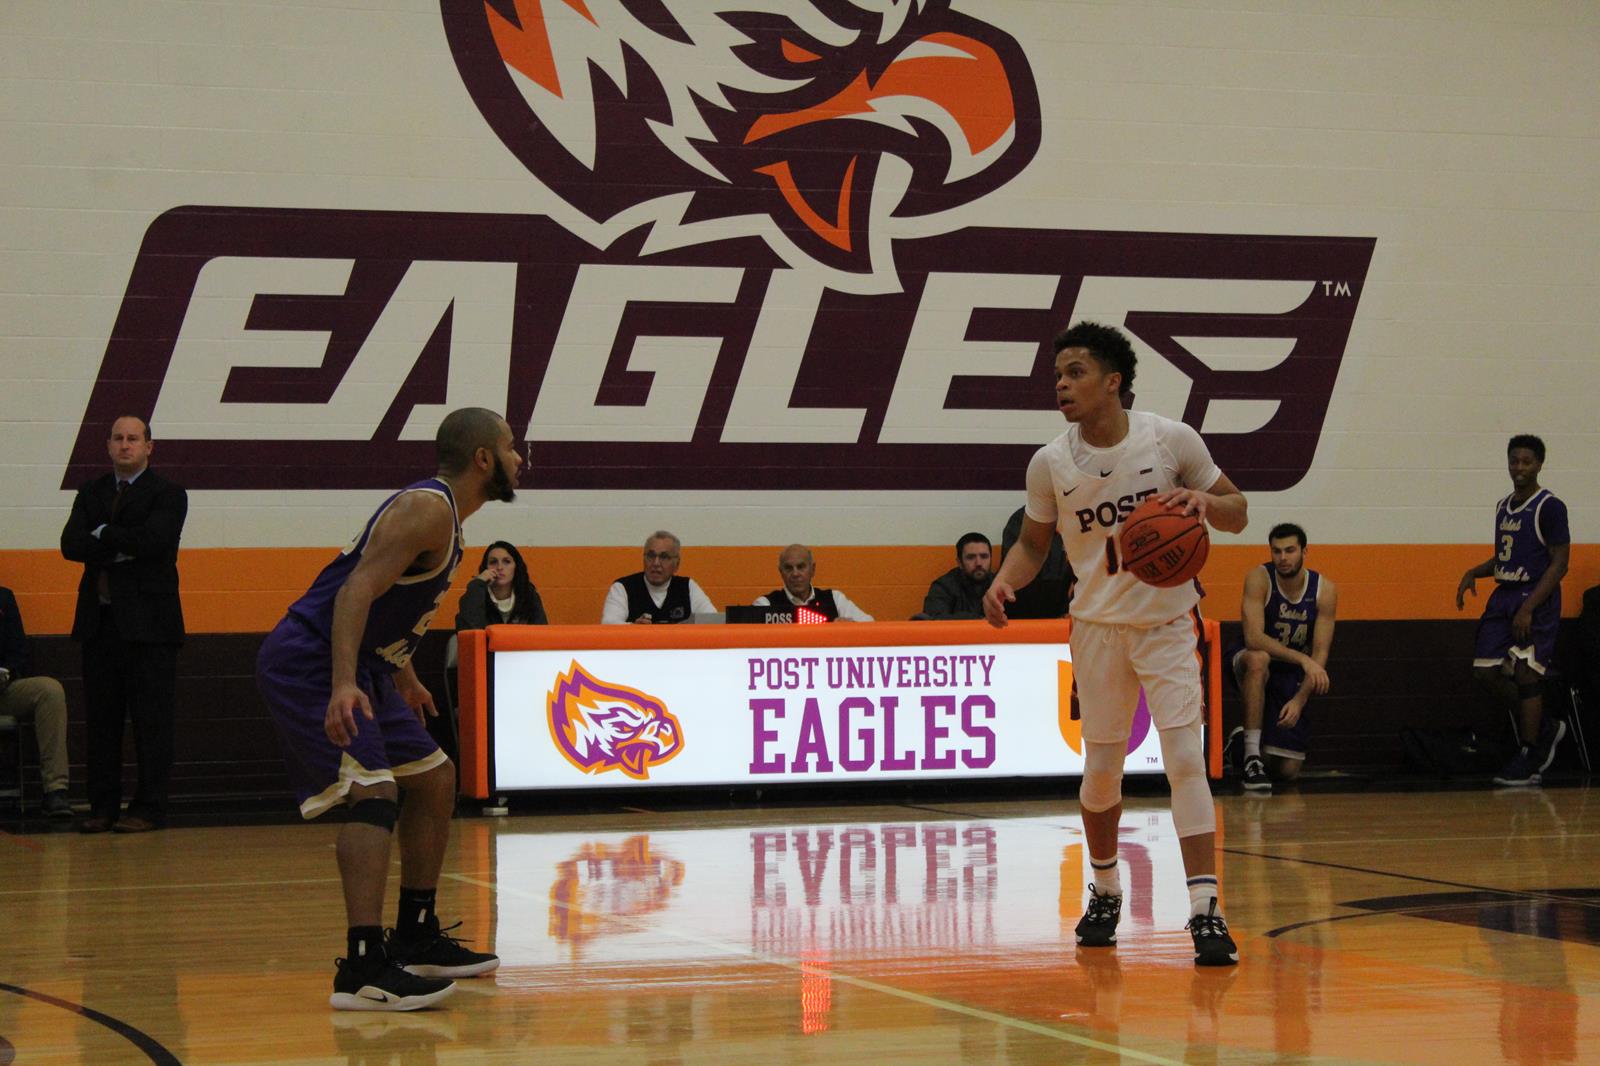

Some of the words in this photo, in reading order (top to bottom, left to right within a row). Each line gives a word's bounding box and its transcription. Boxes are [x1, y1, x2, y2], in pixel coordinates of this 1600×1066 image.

[148, 256, 1318, 444] EAGLES
[1322, 280, 1352, 297] TM
[1498, 534, 1514, 562] 3
[765, 612, 793, 624] POSS
[1274, 621, 1308, 646] 34
[748, 657, 819, 690] POST
[827, 655, 996, 689] UNIVERSITY
[749, 694, 996, 774] EAGLES
